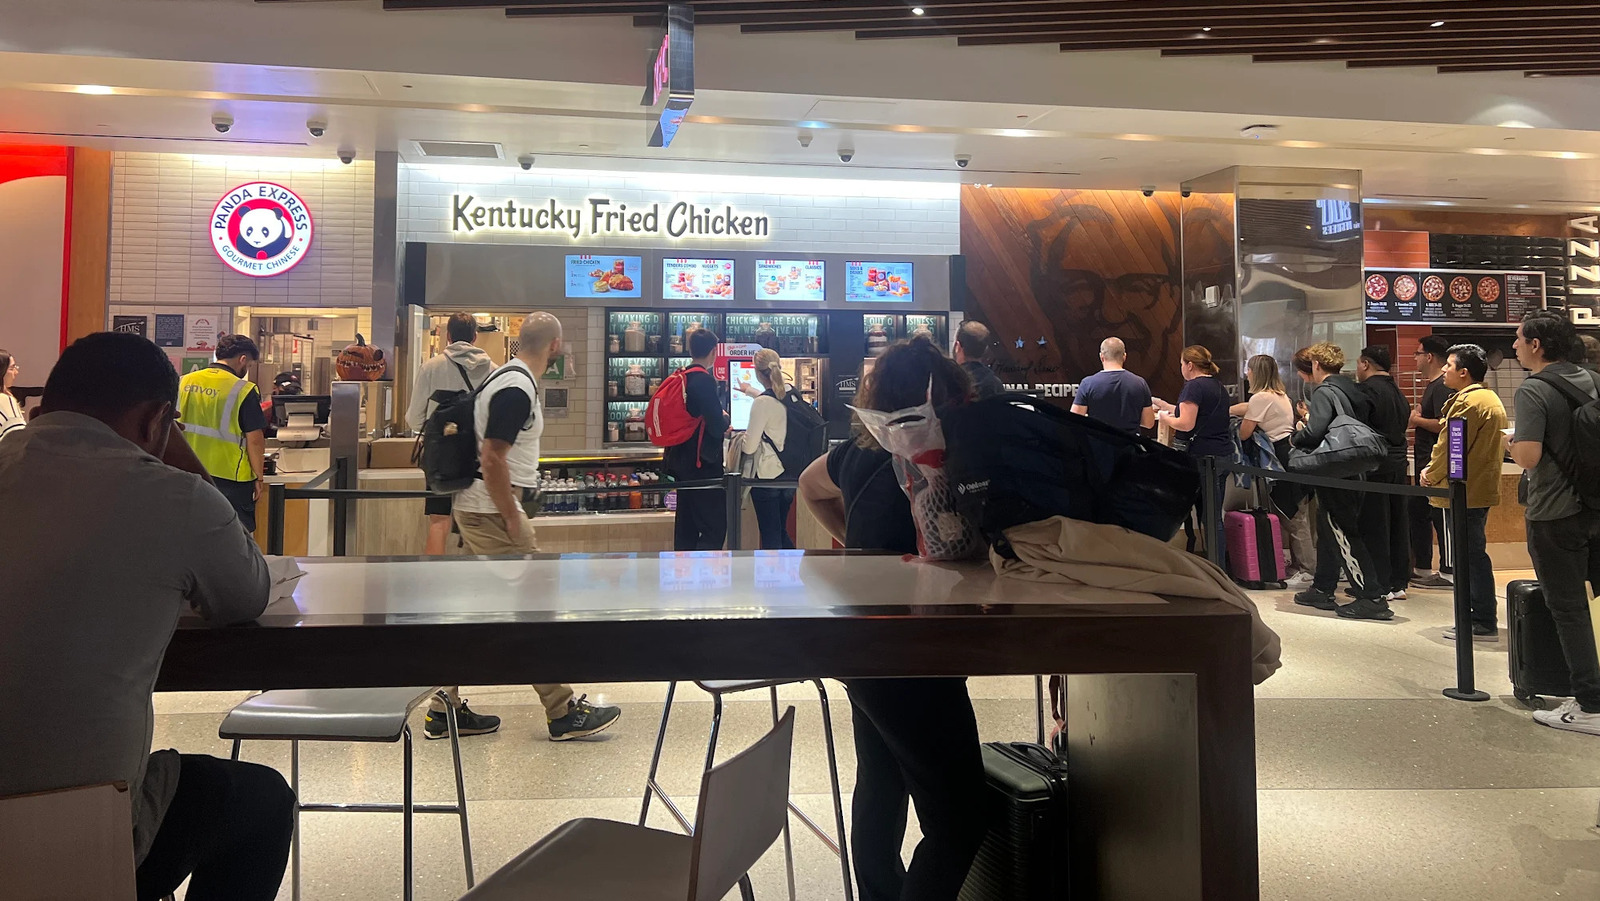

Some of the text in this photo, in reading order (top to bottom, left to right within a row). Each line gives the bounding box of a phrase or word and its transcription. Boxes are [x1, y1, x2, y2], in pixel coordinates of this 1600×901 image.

[214, 186, 308, 231] PANDA EXPRESS
[452, 194, 768, 238] Kentucky Fried Chicken
[222, 245, 300, 271] GOURMET CHINESE
[1567, 215, 1600, 325] PIZZA
[617, 314, 650, 323] MAKING
[700, 315, 718, 324] FRIE
[726, 316, 760, 325] CHICKEN
[628, 358, 658, 367] EVERY
[184, 383, 219, 399] envoy
